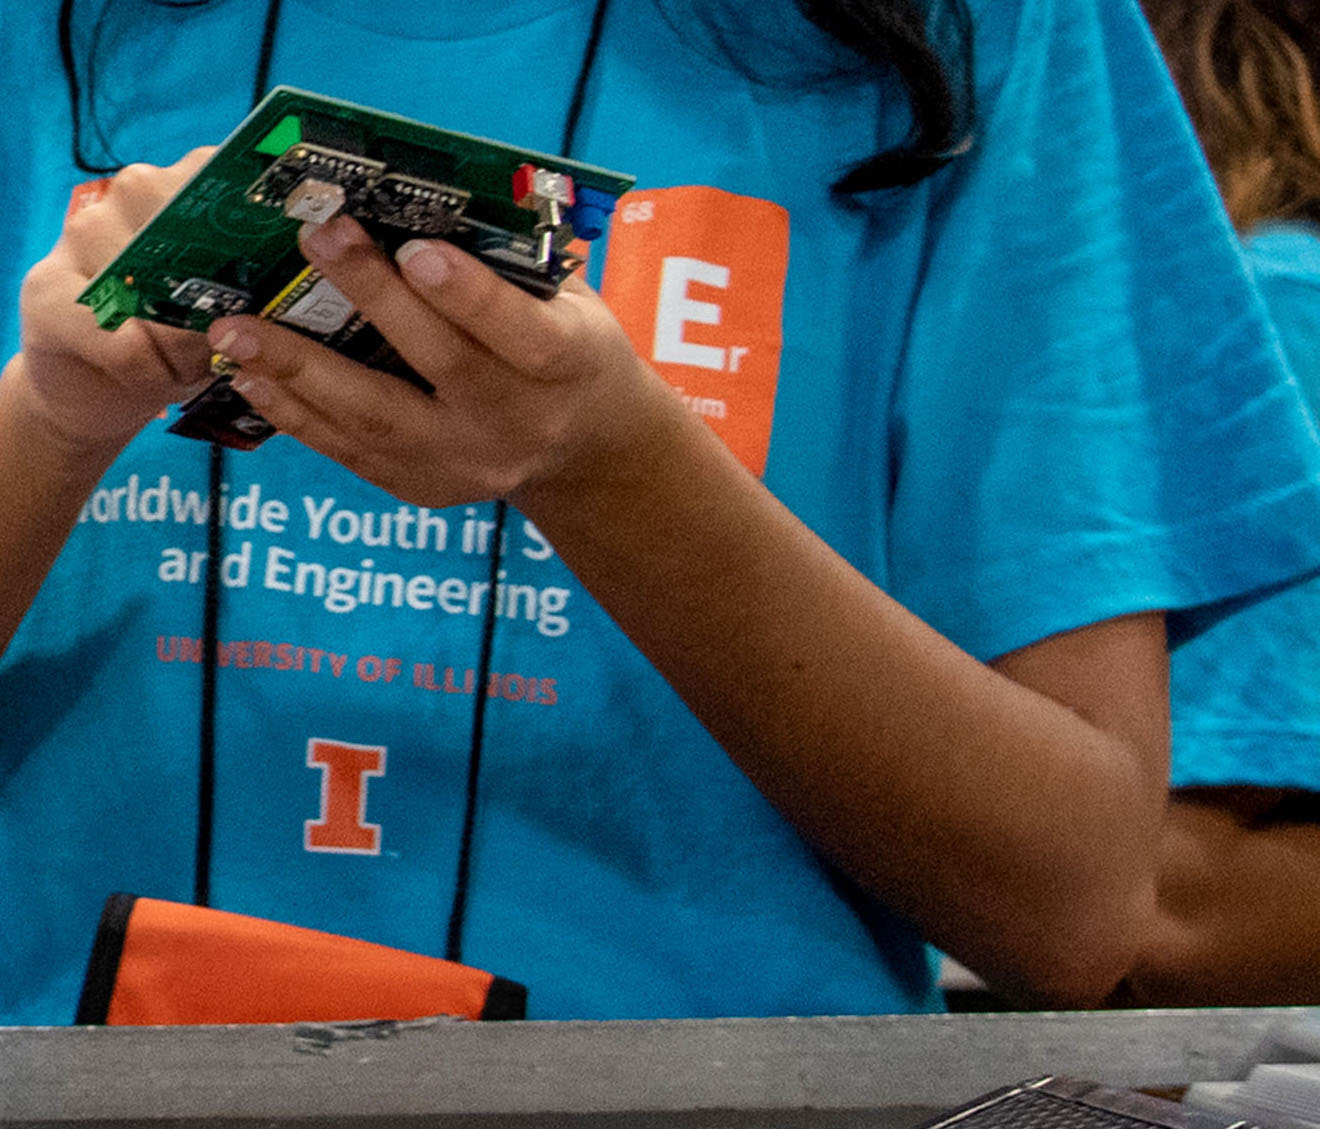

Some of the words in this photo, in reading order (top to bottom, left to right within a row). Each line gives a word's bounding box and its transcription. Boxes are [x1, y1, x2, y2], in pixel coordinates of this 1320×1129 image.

[621, 200, 654, 223] 68
[80, 474, 289, 532] orldwide
[302, 496, 448, 552] Youth
[263, 546, 571, 637] Engineering
[156, 635, 348, 678] UNVERSITY
[357, 655, 402, 683] OF
[304, 737, 387, 855] I
